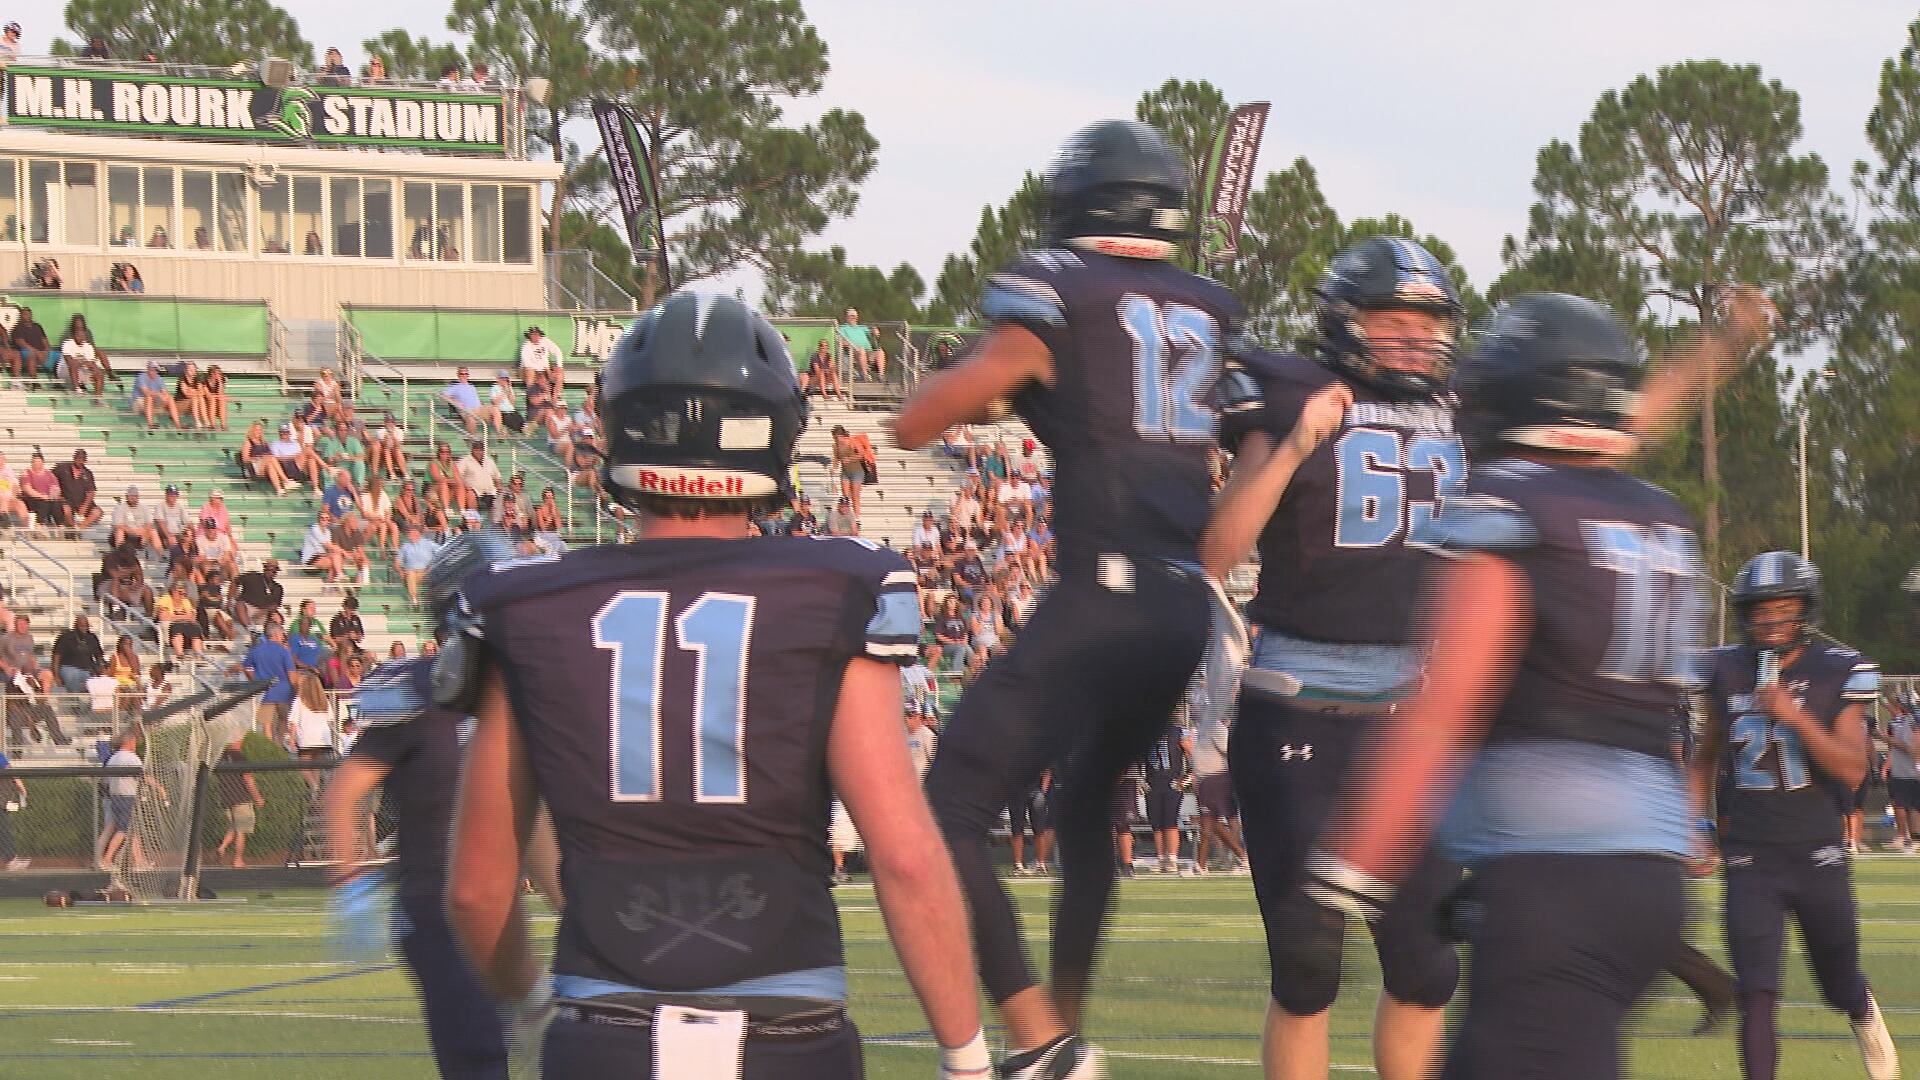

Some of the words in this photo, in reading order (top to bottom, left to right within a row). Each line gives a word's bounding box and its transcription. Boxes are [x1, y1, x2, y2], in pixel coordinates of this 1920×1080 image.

[14, 75, 104, 119] M.H.
[112, 81, 255, 129] ROURK
[323, 95, 497, 143] STADIUM
[1248, 112, 1262, 145] WEST
[607, 109, 642, 212] TROJANS
[1216, 114, 1251, 214] TROJANS
[685, 398, 702, 422] 11
[1115, 292, 1223, 443] 12
[639, 470, 743, 495] Riddell
[1333, 427, 1468, 548] 63
[590, 590, 757, 803] 11
[1729, 716, 1811, 791] 21
